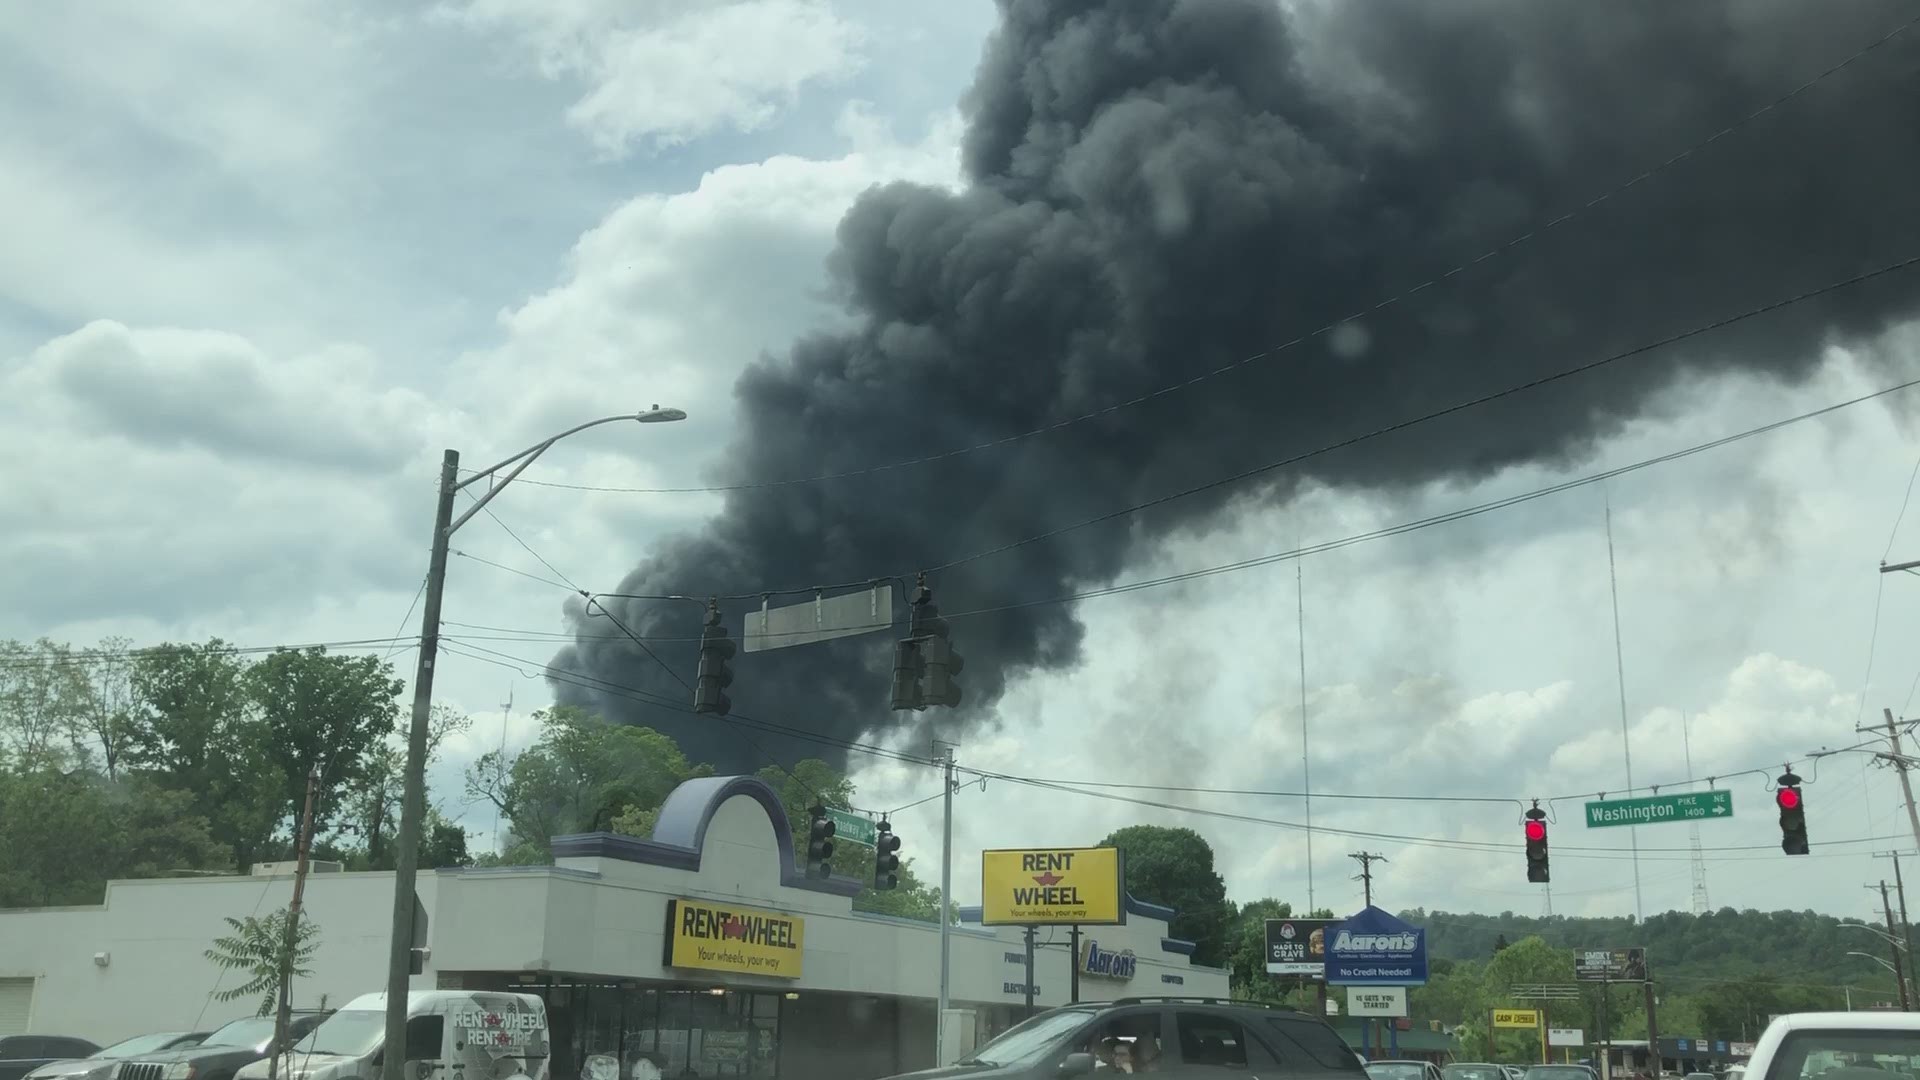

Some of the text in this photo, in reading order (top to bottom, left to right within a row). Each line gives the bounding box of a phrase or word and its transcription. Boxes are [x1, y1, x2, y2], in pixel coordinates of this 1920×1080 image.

[1591, 793, 1726, 822] Washington PIKE NE
[1685, 807, 1706, 817] 1400
[1021, 852, 1075, 872] RENT
[1012, 886, 1085, 906] WHEEL
[1010, 908, 1026, 918] Your
[1055, 909, 1071, 919] your
[1071, 909, 1088, 919] way
[682, 906, 797, 949] RENT WHEEL
[1331, 930, 1418, 953] Aaron's
[697, 945, 716, 961] Your
[746, 953, 765, 968] your
[764, 956, 781, 971] way
[1086, 940, 1137, 980] Aaron's
[1340, 968, 1412, 977] No Credit Needed!
[454, 1011, 546, 1030] RENT WHEEL
[1495, 1013, 1512, 1023] CASH
[467, 1030, 499, 1045] RENT
